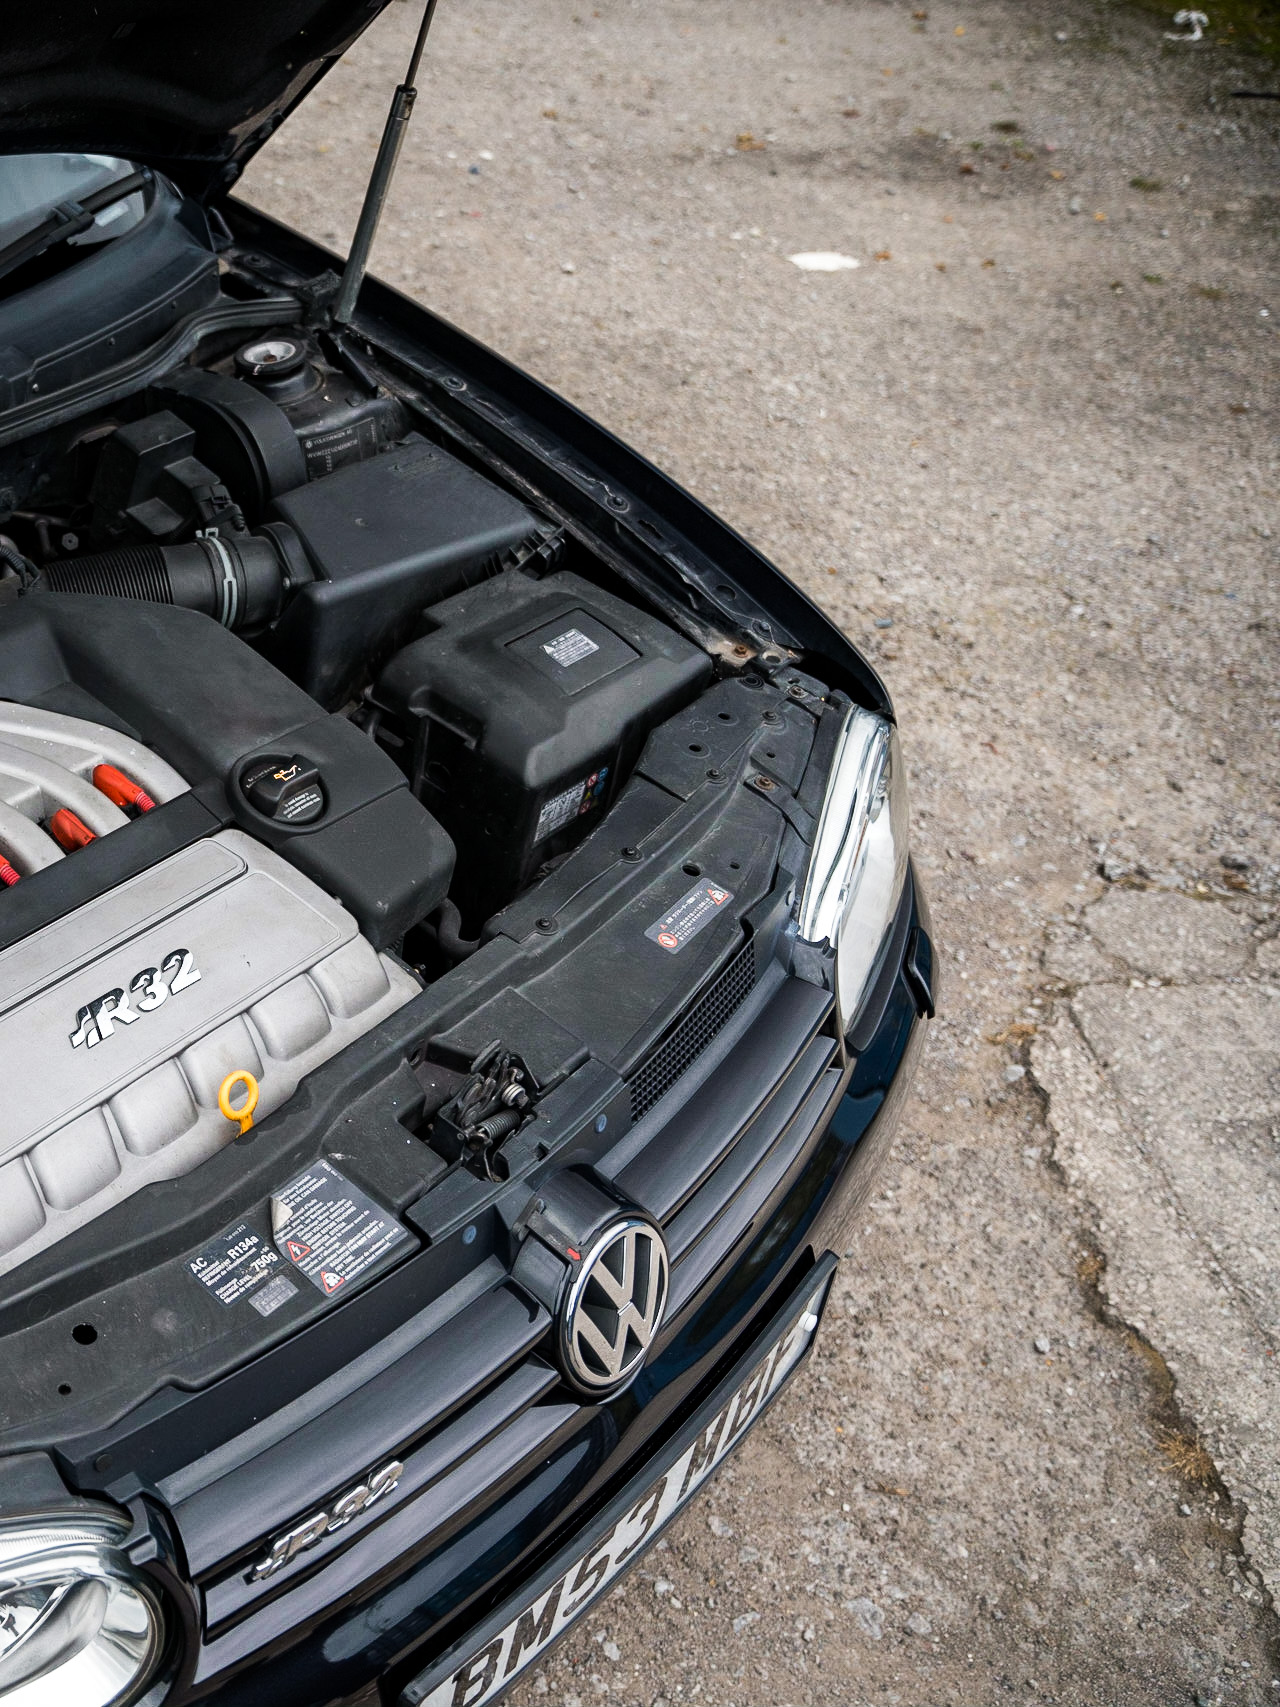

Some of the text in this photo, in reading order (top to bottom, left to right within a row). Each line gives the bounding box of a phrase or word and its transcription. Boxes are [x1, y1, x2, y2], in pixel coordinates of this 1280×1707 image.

[69, 947, 203, 1050] R32
[189, 1256, 209, 1275] AC
[227, 1233, 260, 1260] R134a
[250, 1249, 279, 1274] 750g
[568, 1222, 670, 1388] VW
[252, 1460, 404, 1581] R32
[452, 1475, 671, 1707] BM53
